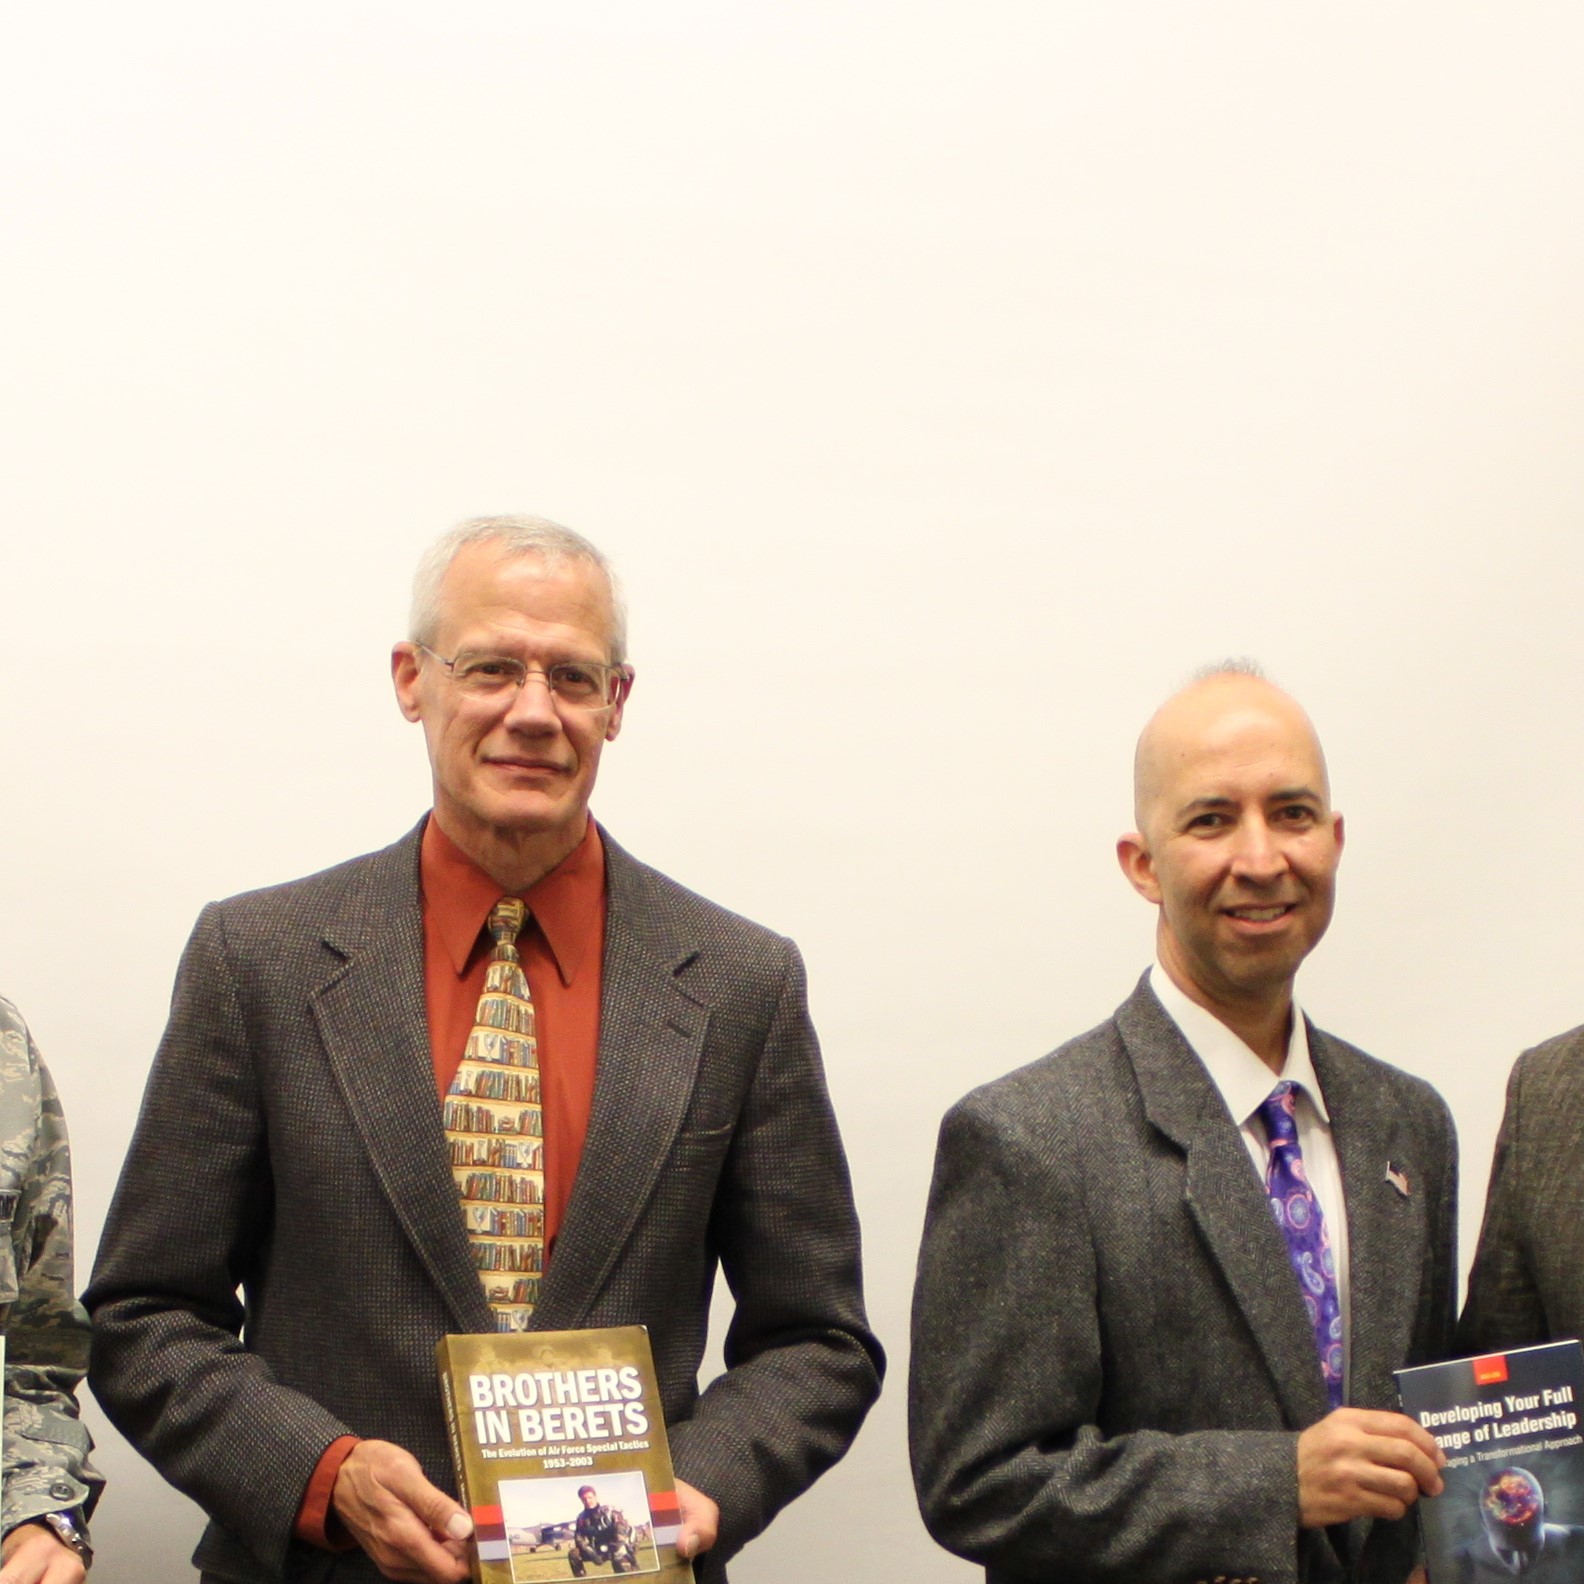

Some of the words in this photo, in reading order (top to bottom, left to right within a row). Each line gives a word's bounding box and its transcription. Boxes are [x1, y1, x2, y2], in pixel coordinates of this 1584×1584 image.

[469, 1366, 643, 1408] BROTHERS
[474, 1410, 512, 1445] IN
[518, 1401, 649, 1443] BERETS
[1419, 1401, 1503, 1429] Developing
[1504, 1394, 1541, 1414] Your
[1541, 1386, 1574, 1407] Full
[481, 1448, 497, 1459] The
[498, 1446, 537, 1459] Evolution
[538, 1445, 547, 1456] of
[548, 1445, 561, 1456] Air
[561, 1444, 586, 1456] Force
[586, 1441, 618, 1456] Special
[618, 1440, 650, 1450] Tactics
[1435, 1433, 1472, 1450] ange
[1474, 1424, 1490, 1443] of
[1493, 1410, 1577, 1440] Leadership
[1476, 1440, 1543, 1462] Transformational
[1543, 1434, 1584, 1450] Approach
[543, 1456, 594, 1470] 1953-2003
